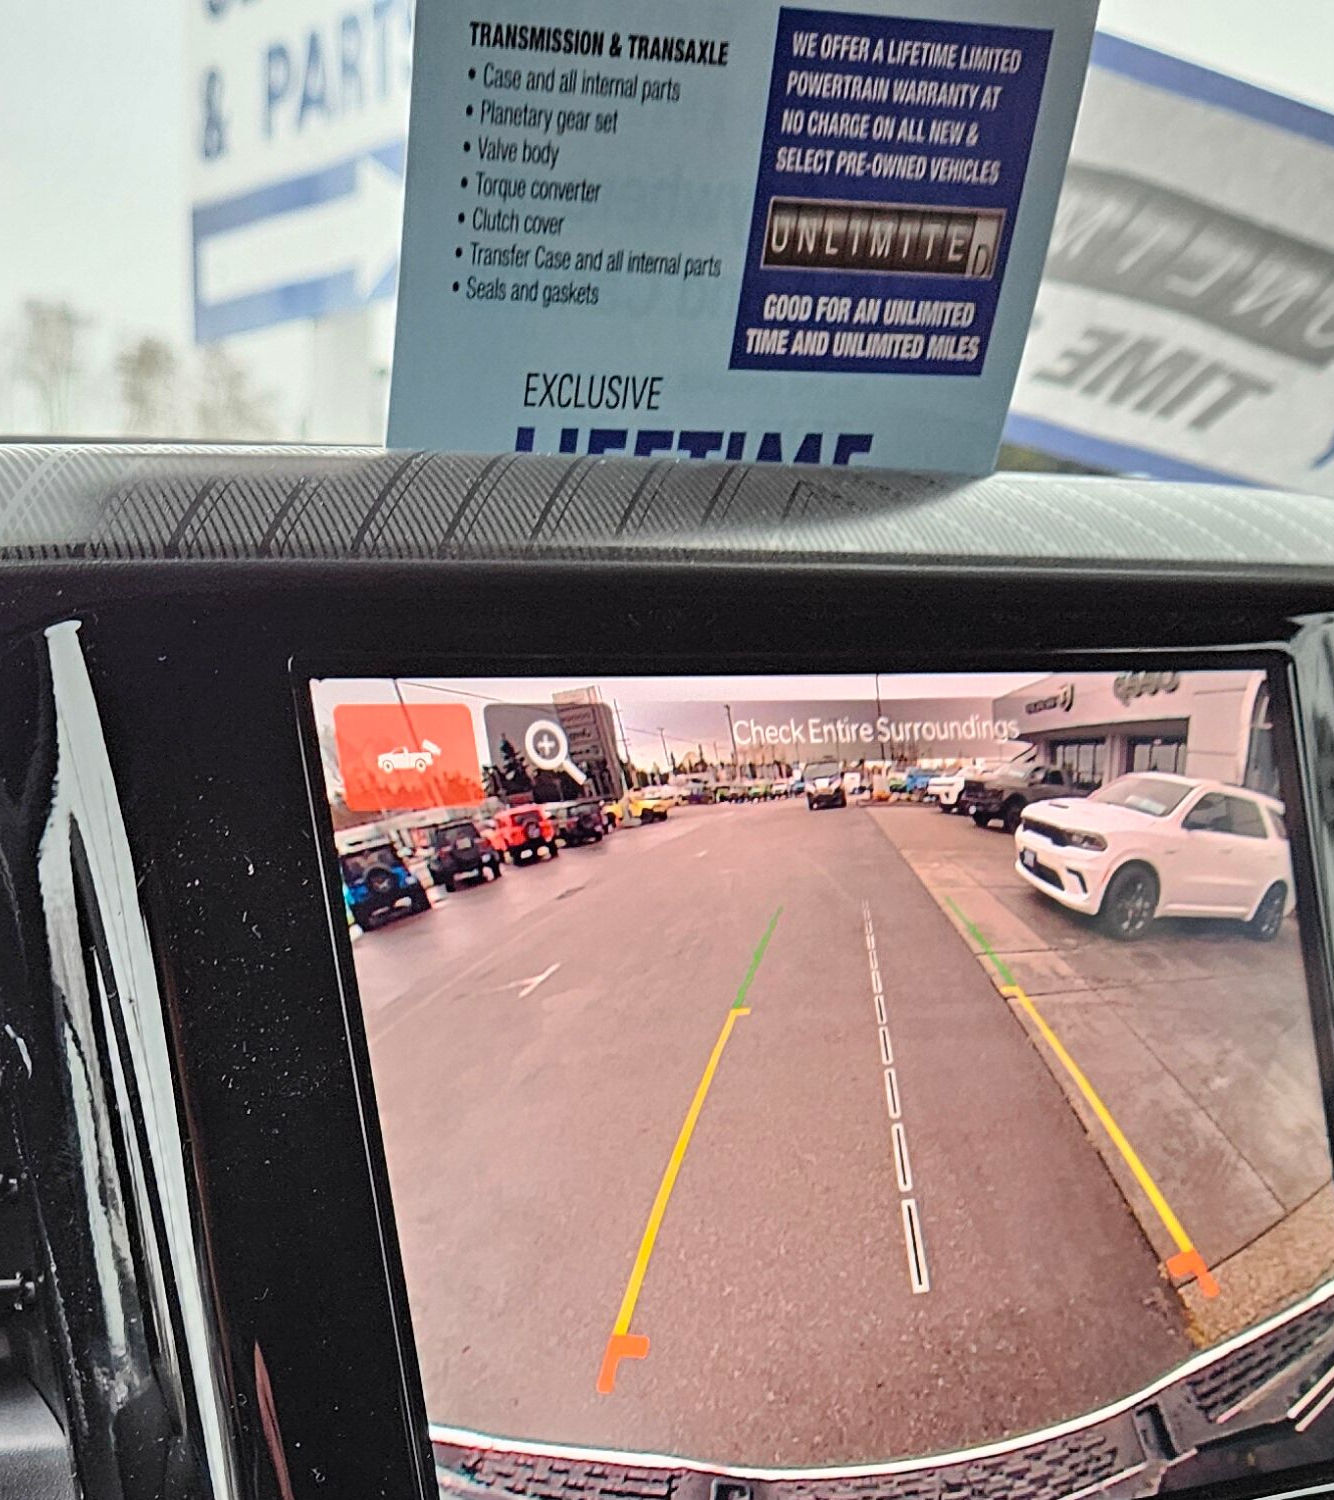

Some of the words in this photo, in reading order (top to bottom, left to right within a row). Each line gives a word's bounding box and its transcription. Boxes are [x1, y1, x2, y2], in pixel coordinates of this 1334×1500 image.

[470, 21, 604, 55] TRANSMISSION
[610, 32, 623, 58] &
[628, 34, 730, 66] TRANSAXLE
[792, 30, 818, 58] WE
[820, 33, 870, 63] OFFER
[872, 38, 884, 63] A
[887, 39, 958, 70] LIFETIME
[959, 45, 1022, 75] LIMITED
[264, 0, 414, 138] PART
[483, 62, 521, 90] Case
[526, 66, 555, 93] and
[559, 69, 577, 95] all
[581, 71, 638, 99] internal
[642, 77, 680, 106] parts
[786, 70, 889, 103] POWERTRAIN
[892, 78, 980, 108] WARRANTY
[980, 85, 1002, 111] AT
[481, 99, 552, 135] Planetary
[557, 112, 591, 136] gear
[595, 110, 618, 134] set
[781, 108, 803, 135] NO
[807, 111, 871, 140] CHARGE
[872, 115, 896, 142] ON
[897, 118, 926, 144] ALL
[929, 120, 967, 146] NEW
[966, 122, 979, 147] &
[478, 135, 517, 161] Valve
[522, 139, 560, 170] body
[775, 147, 834, 176] SELECT
[835, 151, 927, 181] PRE-OWNED
[930, 156, 1001, 186] VEHICLES
[476, 171, 526, 202] Torque
[531, 179, 601, 203] converter
[472, 206, 518, 233] Clutch
[524, 215, 565, 235] cover
[470, 242, 530, 268] Transfer
[534, 245, 571, 271] Case
[575, 248, 601, 272] and
[606, 249, 623, 273] all
[627, 251, 680, 276] internal
[684, 256, 721, 281] parts
[771, 211, 991, 276] UNLIMITED
[466, 275, 506, 301] Seals
[511, 279, 538, 301] and
[542, 281, 599, 308] gaskets
[763, 294, 812, 321] GOOD
[815, 296, 851, 324] FOR
[853, 298, 882, 325] AN
[883, 300, 975, 328] UNLIMITED
[746, 328, 789, 355] TIME
[791, 329, 832, 357] AND
[832, 332, 924, 360] UNLIMITED
[926, 335, 981, 362] MILES
[524, 373, 663, 410] EXCLUSIVE
[734, 719, 806, 746] Check
[809, 717, 874, 743] Entire
[877, 714, 1020, 742] Surroundings
